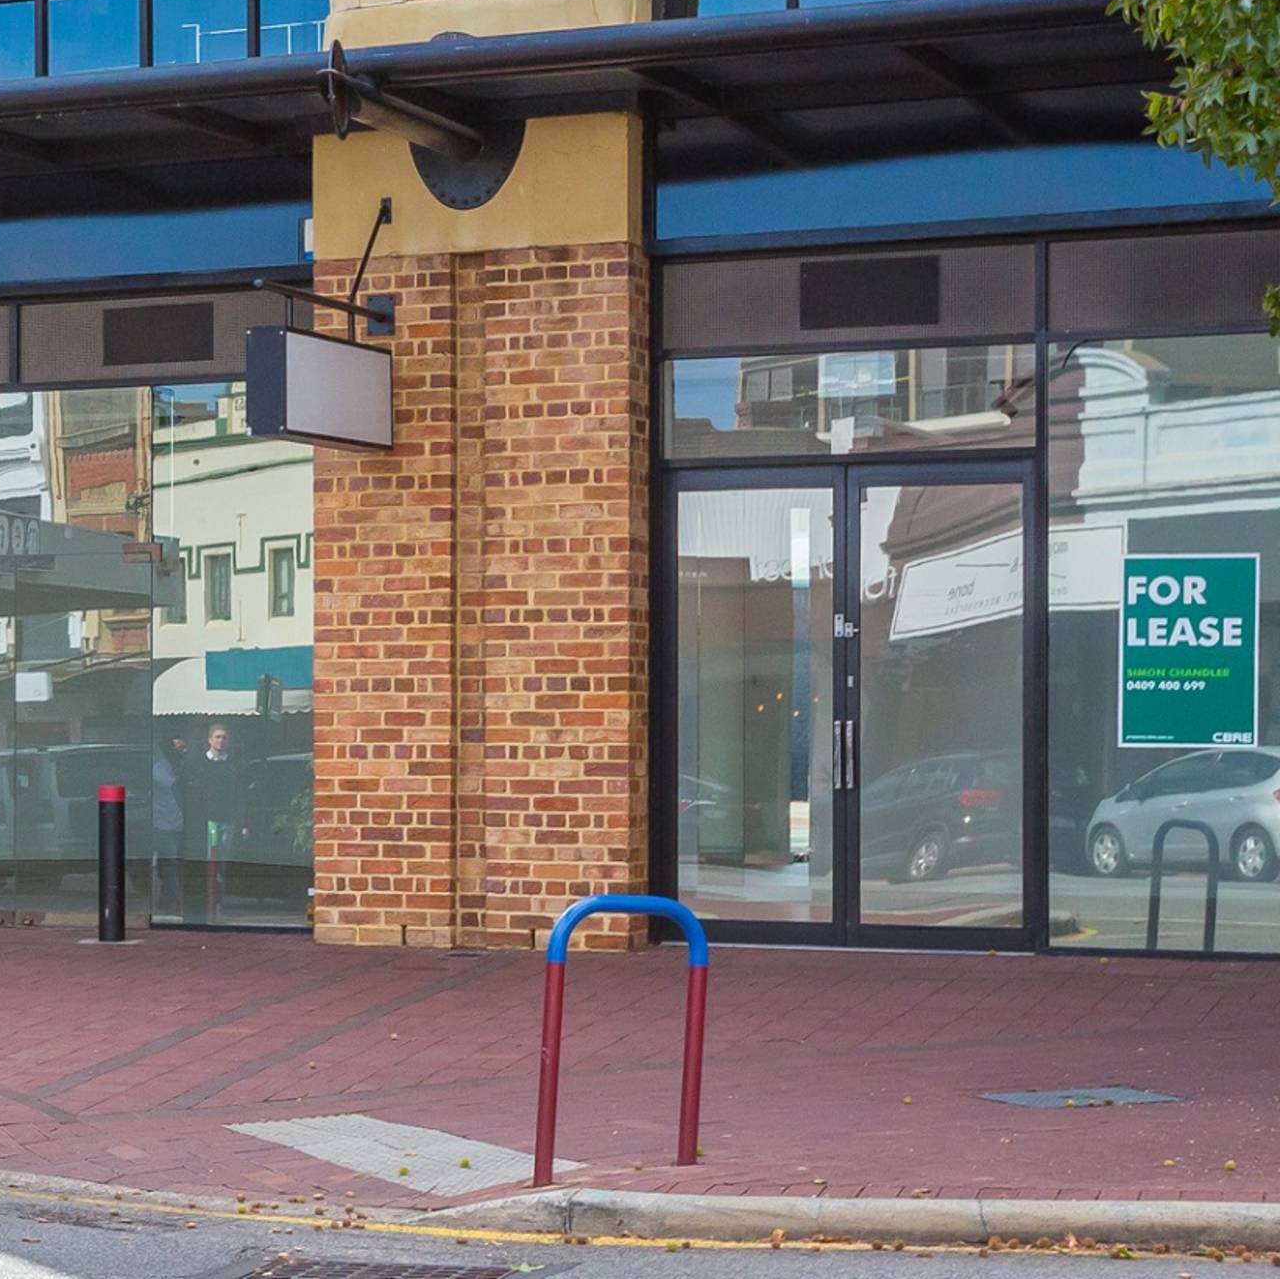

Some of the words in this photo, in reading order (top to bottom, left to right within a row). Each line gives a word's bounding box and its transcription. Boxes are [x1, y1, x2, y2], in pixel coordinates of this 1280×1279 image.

[1127, 576, 1207, 605] FOR
[1127, 617, 1243, 647] LEASE
[1127, 668, 1165, 677] SIMON
[1168, 667, 1230, 677] CHANDLER
[1183, 681, 1206, 690] 699
[1212, 732, 1252, 743] CBRE
